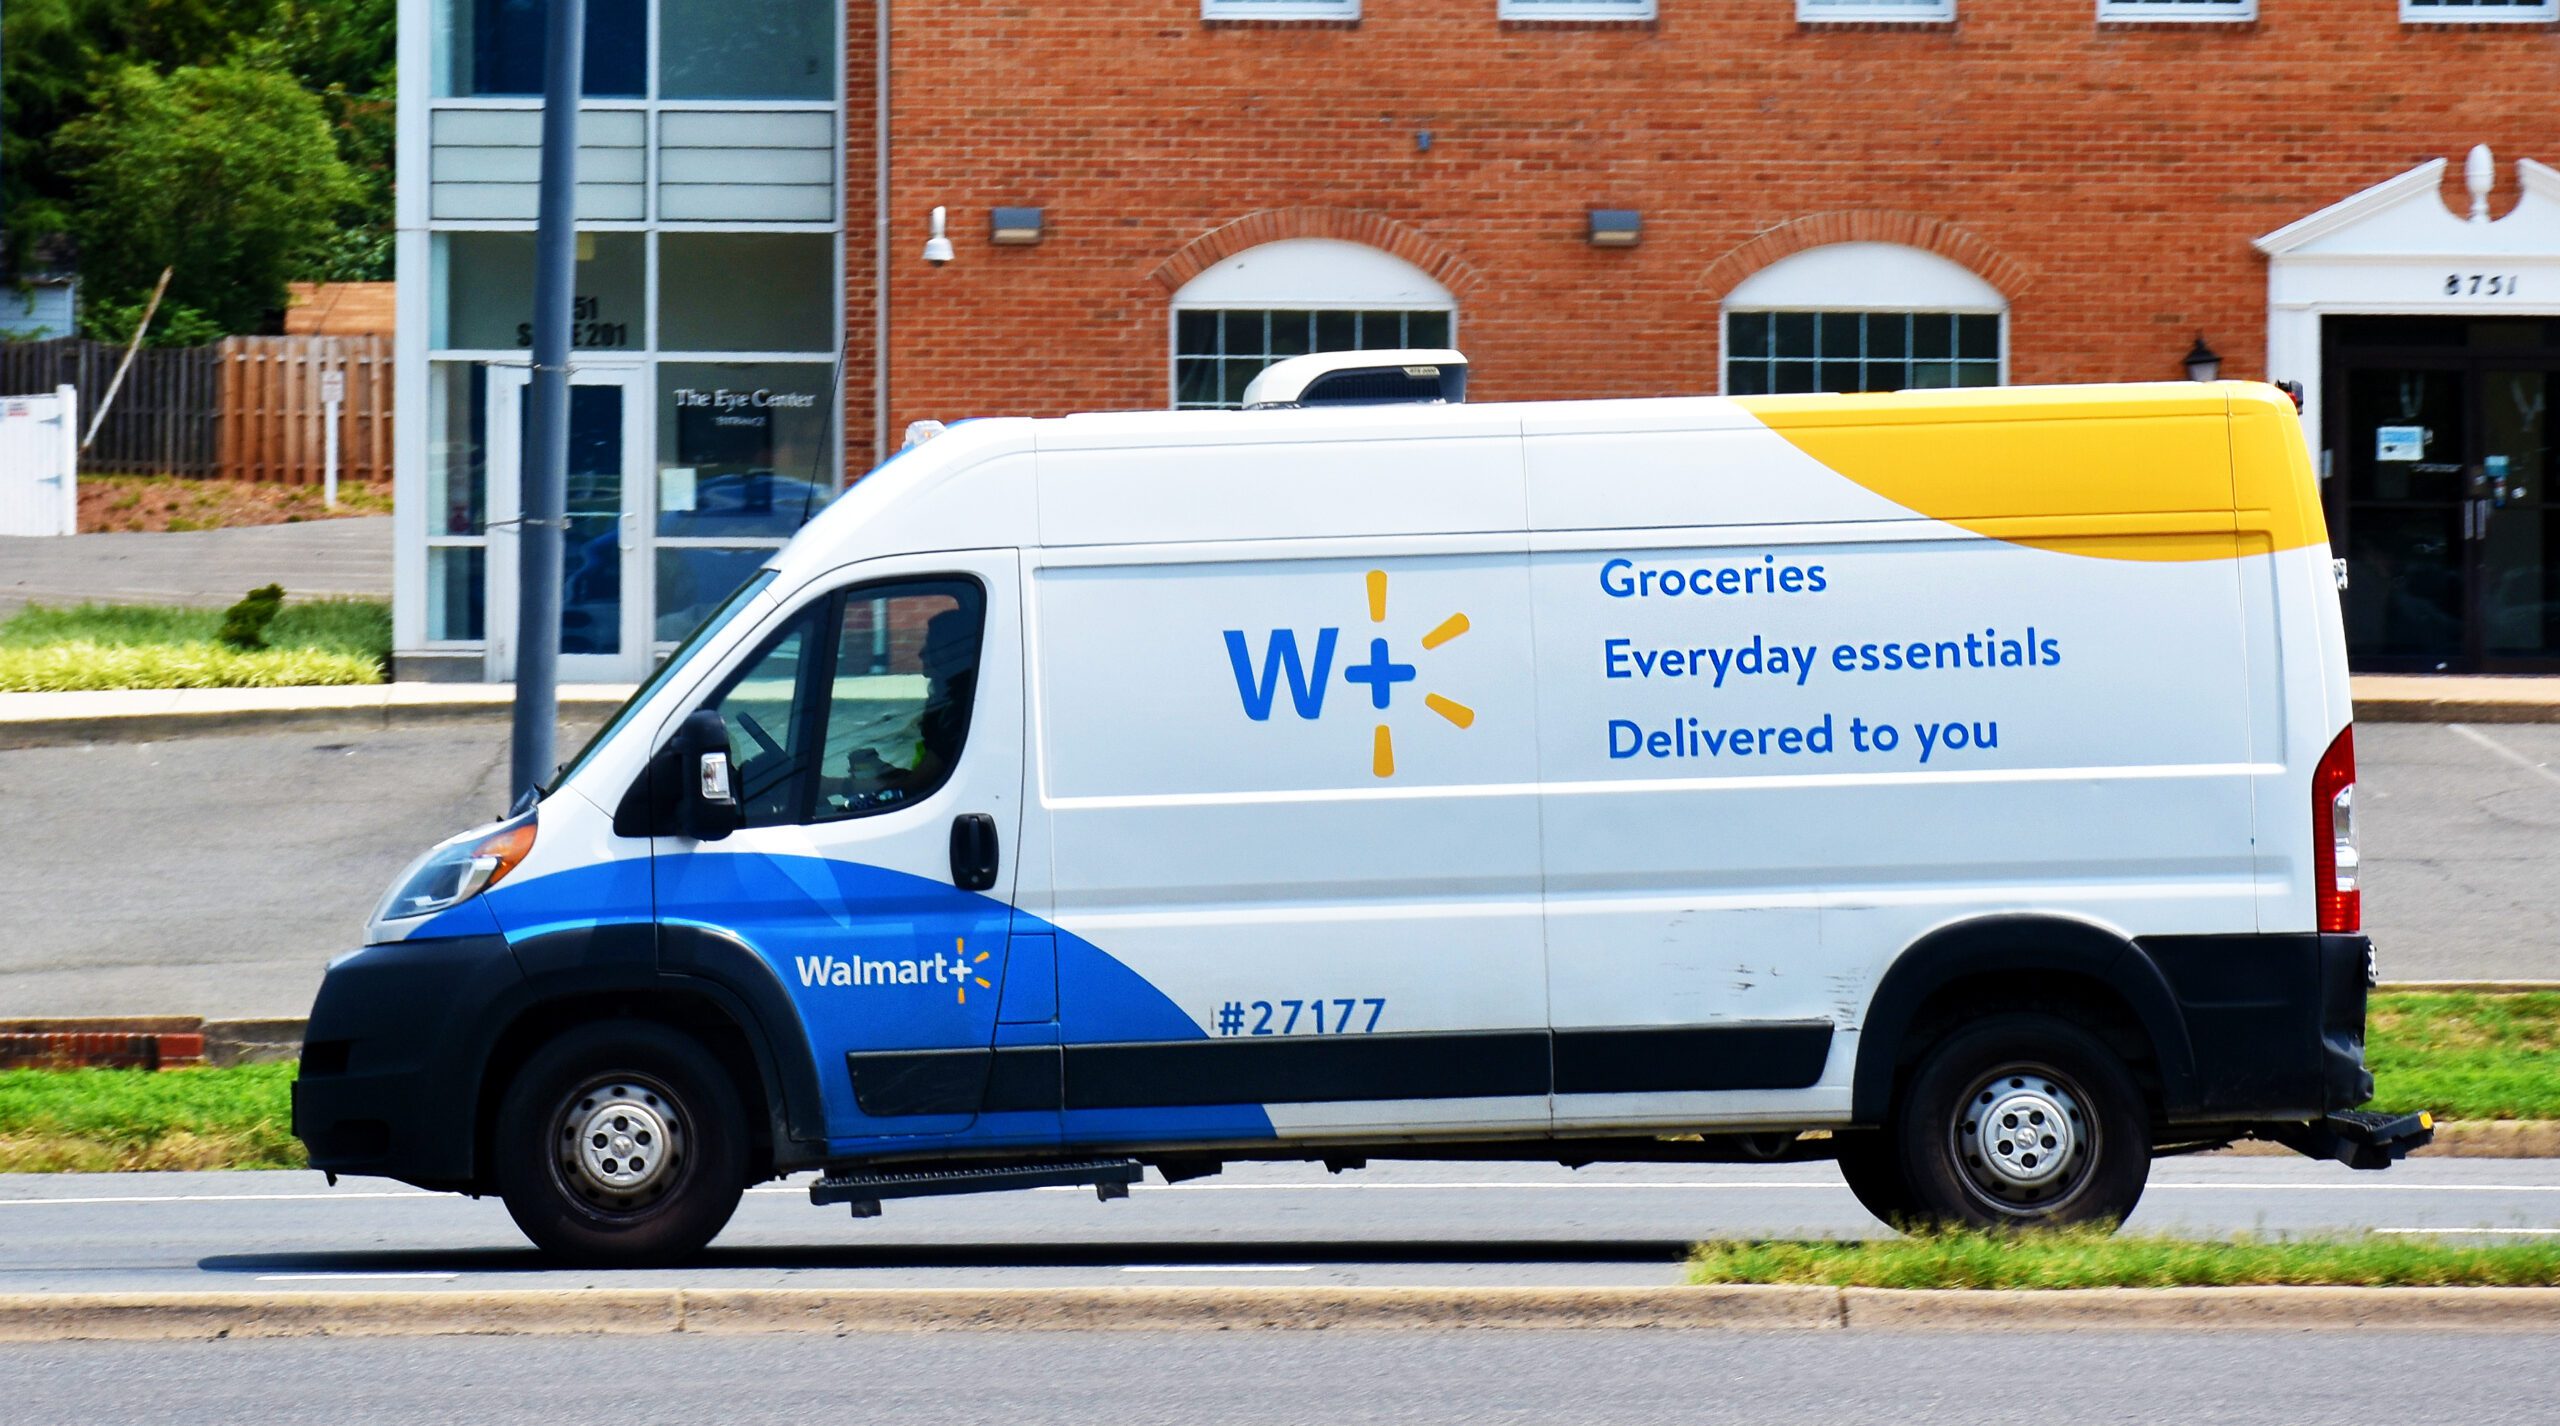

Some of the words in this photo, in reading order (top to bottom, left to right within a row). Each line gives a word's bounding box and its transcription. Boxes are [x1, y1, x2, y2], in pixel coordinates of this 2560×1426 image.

[2444, 273, 2518, 295] 8751
[585, 322, 627, 347] 201
[673, 388, 711, 407] The
[714, 388, 749, 412] Eye
[751, 387, 816, 408] Center
[1600, 554, 1827, 597] Groceries
[1605, 635, 1817, 688] Everyday
[1832, 627, 2061, 672] essentials
[1608, 713, 1834, 759] Delivered
[1850, 717, 1899, 752] to
[1914, 721, 1998, 763] you
[1218, 998, 1386, 1036] #27177
